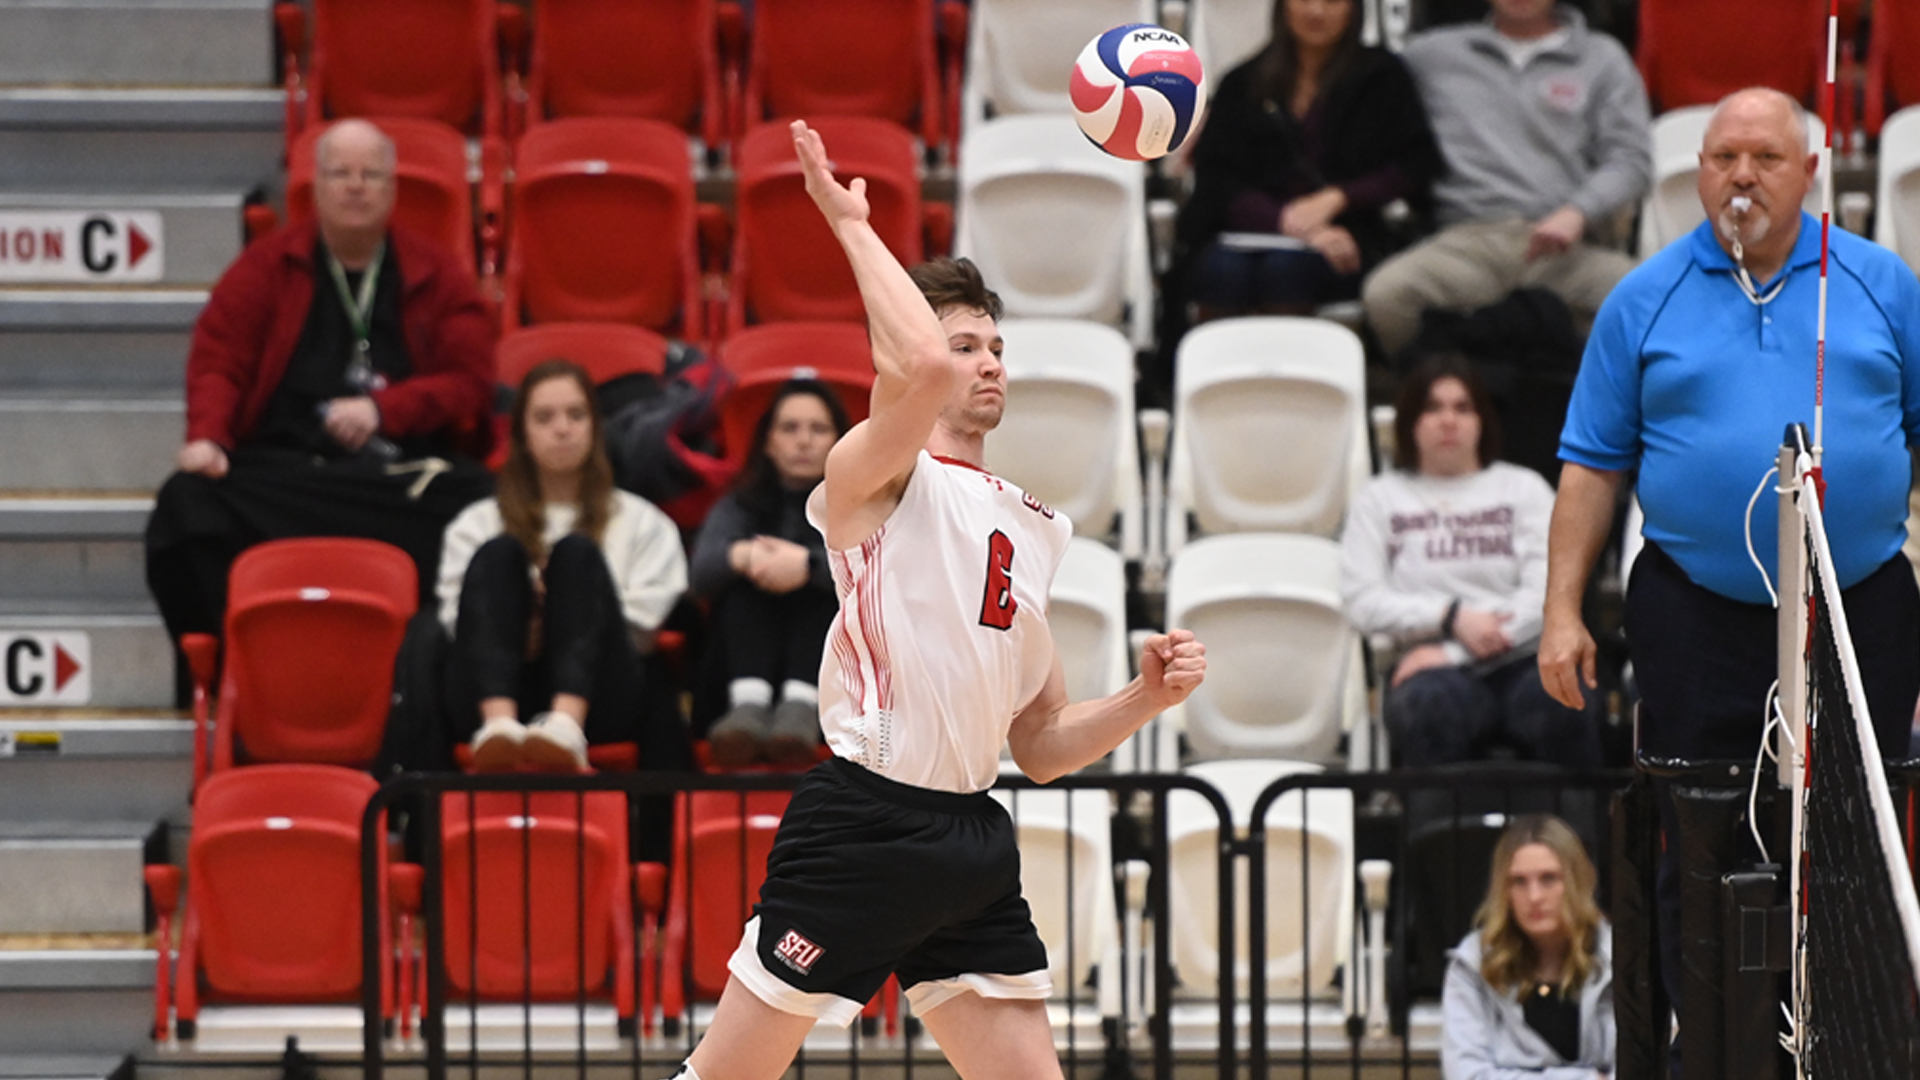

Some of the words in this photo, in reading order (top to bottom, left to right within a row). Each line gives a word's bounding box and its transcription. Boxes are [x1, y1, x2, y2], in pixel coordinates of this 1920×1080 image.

[1133, 31, 1181, 45] NCAA
[0, 228, 63, 261] ION
[81, 216, 117, 273] C
[979, 528, 1018, 631] 6
[6, 637, 43, 696] C
[776, 929, 825, 969] SFU
